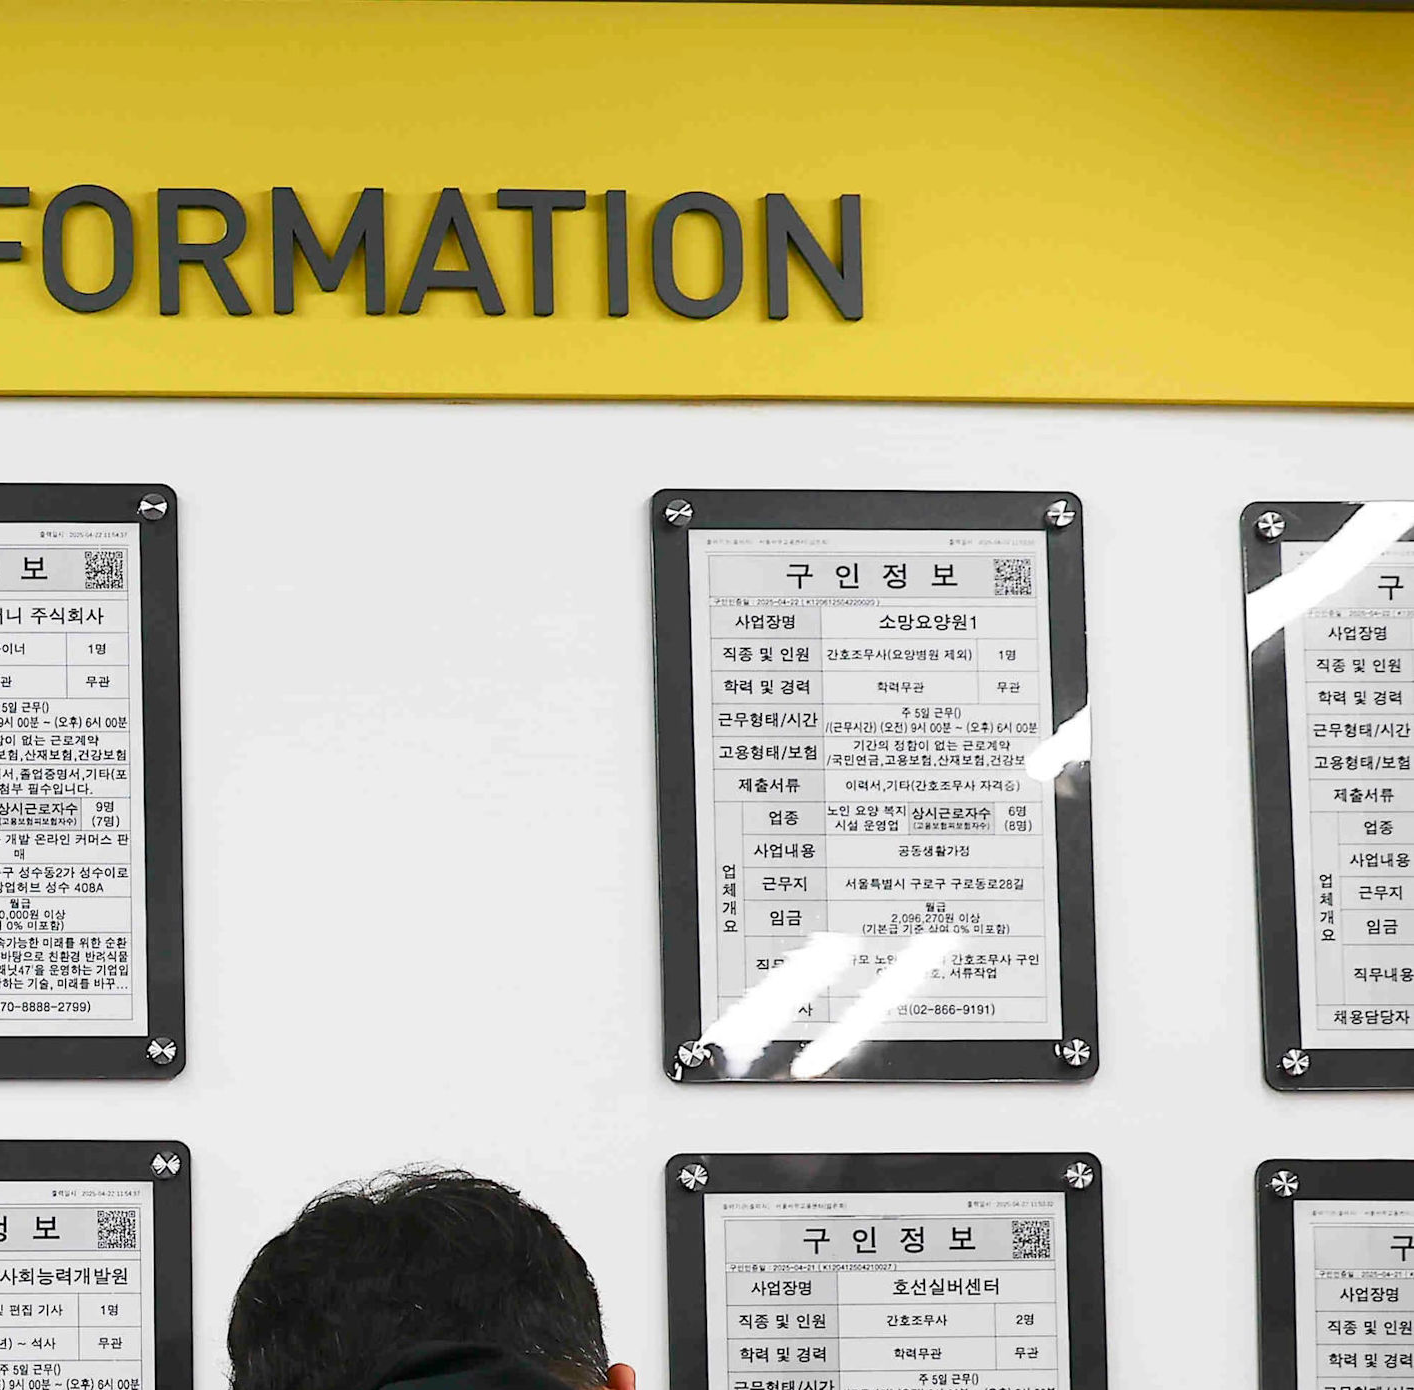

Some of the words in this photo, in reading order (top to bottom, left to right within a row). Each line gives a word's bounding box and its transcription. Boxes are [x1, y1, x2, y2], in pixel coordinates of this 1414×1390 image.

[30, 607, 105, 625] 주식회사
[878, 613, 976, 631] 소망요양원1
[1328, 625, 1387, 642] 사업장명
[944, 648, 973, 662] 제외)
[717, 712, 819, 728] 근무형태/시간
[898, 844, 970, 858] 공동생활가정
[1349, 852, 1411, 868] 사업내용
[74, 882, 104, 894] 408A
[910, 878, 947, 891] 구로구
[1358, 885, 1403, 901] 근무지
[949, 967, 997, 980] 서류작업
[1333, 1009, 1411, 1025] 채용담당자
[892, 1277, 999, 1296] 호선실버센터
[1339, 1286, 1399, 1303] 사업장명
[9, 1303, 33, 1317] 편집
[38, 1303, 64, 1317] 기사
[886, 1313, 948, 1327] 간호조무사
[31, 1337, 56, 1350] 석사
